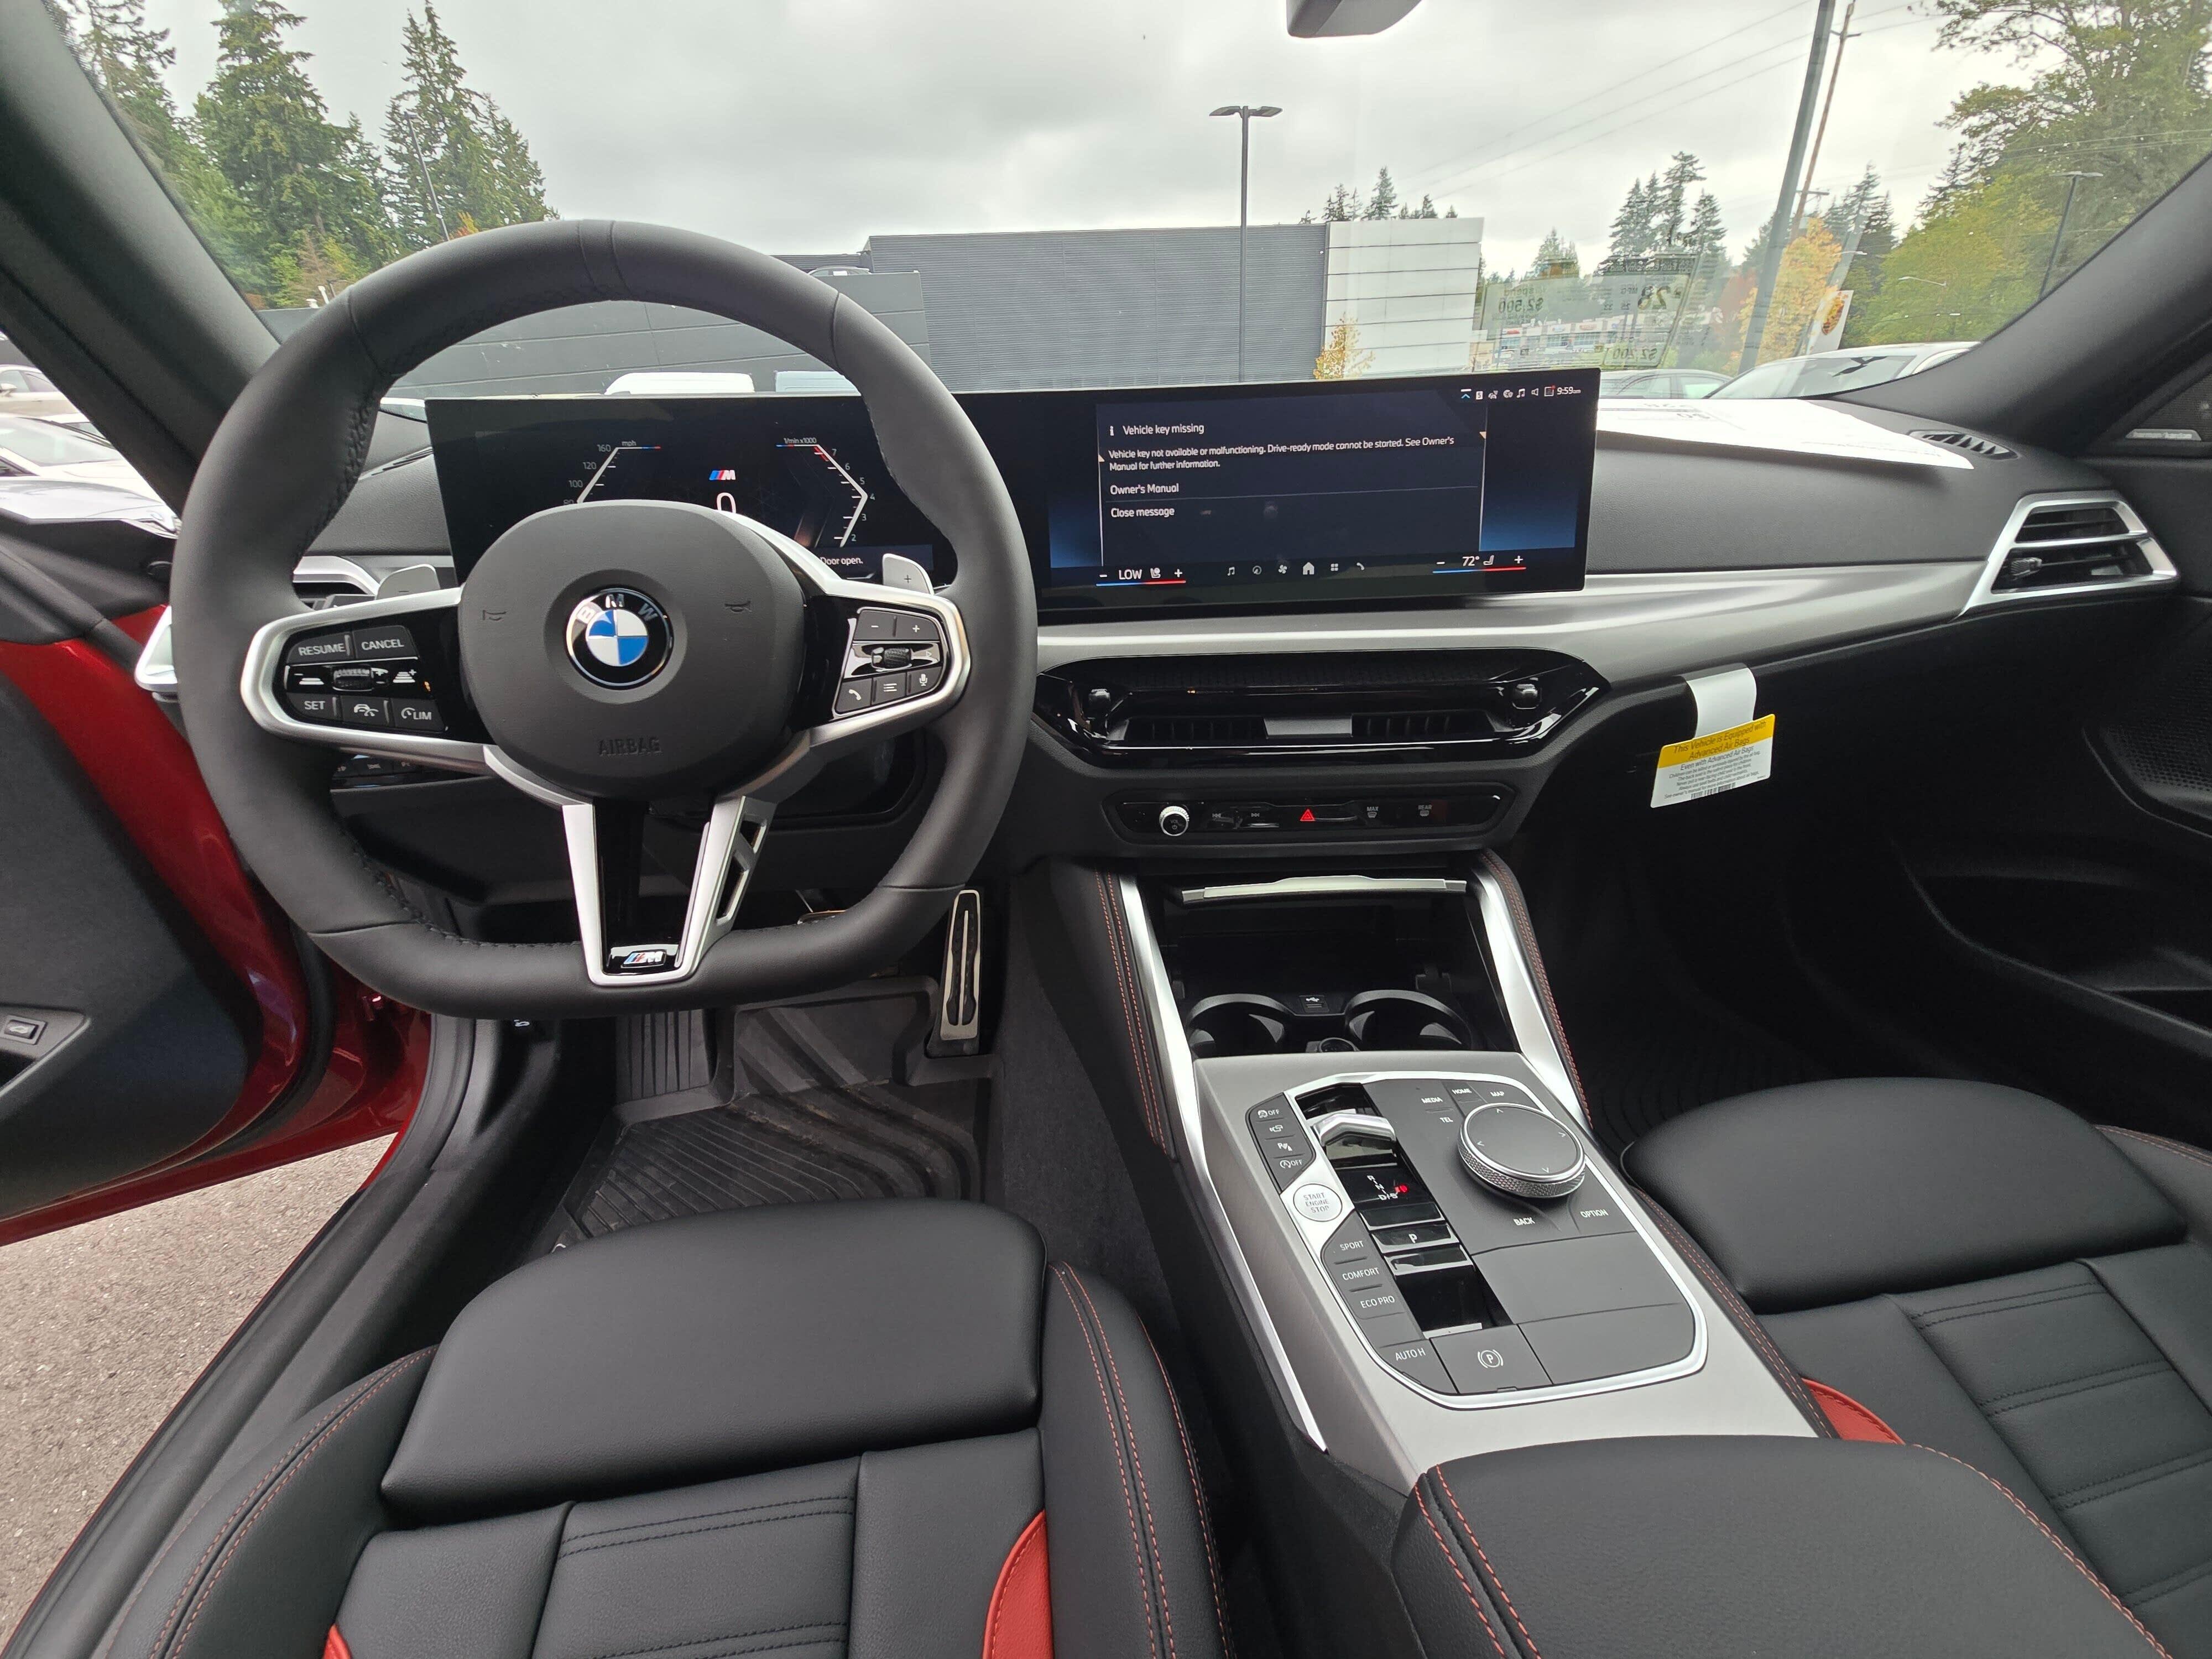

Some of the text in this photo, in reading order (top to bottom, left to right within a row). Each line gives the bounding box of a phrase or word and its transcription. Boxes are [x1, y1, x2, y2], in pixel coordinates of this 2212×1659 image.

[1123, 423, 1204, 436] Vehicle key missing
[597, 444, 612, 452] 160
[1108, 450, 1135, 459] Vehicle
[1137, 449, 1150, 459] key
[1151, 448, 1164, 457] not
[1165, 447, 1198, 457] available
[1209, 445, 1266, 456] malfunctioning.
[1267, 441, 1311, 453] Drive-ready
[1312, 441, 1334, 451] mode
[1335, 441, 1362, 450] cannot
[1363, 440, 1373, 448] be
[1375, 439, 1404, 448] started.
[1405, 438, 1420, 447] See
[1422, 436, 1454, 446] Owner's
[1109, 460, 1220, 471] Manual for further information.
[568, 479, 583, 488] 100
[1110, 483, 1179, 494] Owner's Manual
[1110, 507, 1175, 518] Close message
[820, 557, 863, 566] Door open.
[1118, 569, 1142, 580] LOW
[576, 593, 658, 624] BMW
[298, 643, 346, 656] RESUME
[361, 639, 405, 651] CANCEL
[304, 700, 325, 711] SET
[413, 711, 432, 721] LIM
[1673, 744, 1688, 754] This
[1691, 737, 1716, 750] Vehicle
[1724, 727, 1753, 741] Equipped
[1754, 721, 1766, 731] with
[1689, 738, 1750, 759] Advanced Air Bags
[1681, 762, 1695, 770] Even
[1695, 759, 1707, 767] with
[1707, 752, 1733, 763] Advanced
[1741, 745, 1754, 754] Bags
[1303, 1192, 1325, 1201] START
[1310, 1205, 1329, 1213] STOP
[1580, 1209, 1609, 1218] OPTION
[1513, 1217, 1535, 1227] BACK
[1408, 1233, 1417, 1244] P
[1340, 1240, 1364, 1251] SPORT
[1342, 1267, 1380, 1281] COMFORT
[1360, 1295, 1395, 1309] ECO PRO
[1395, 1347, 1426, 1361] AUTO H
